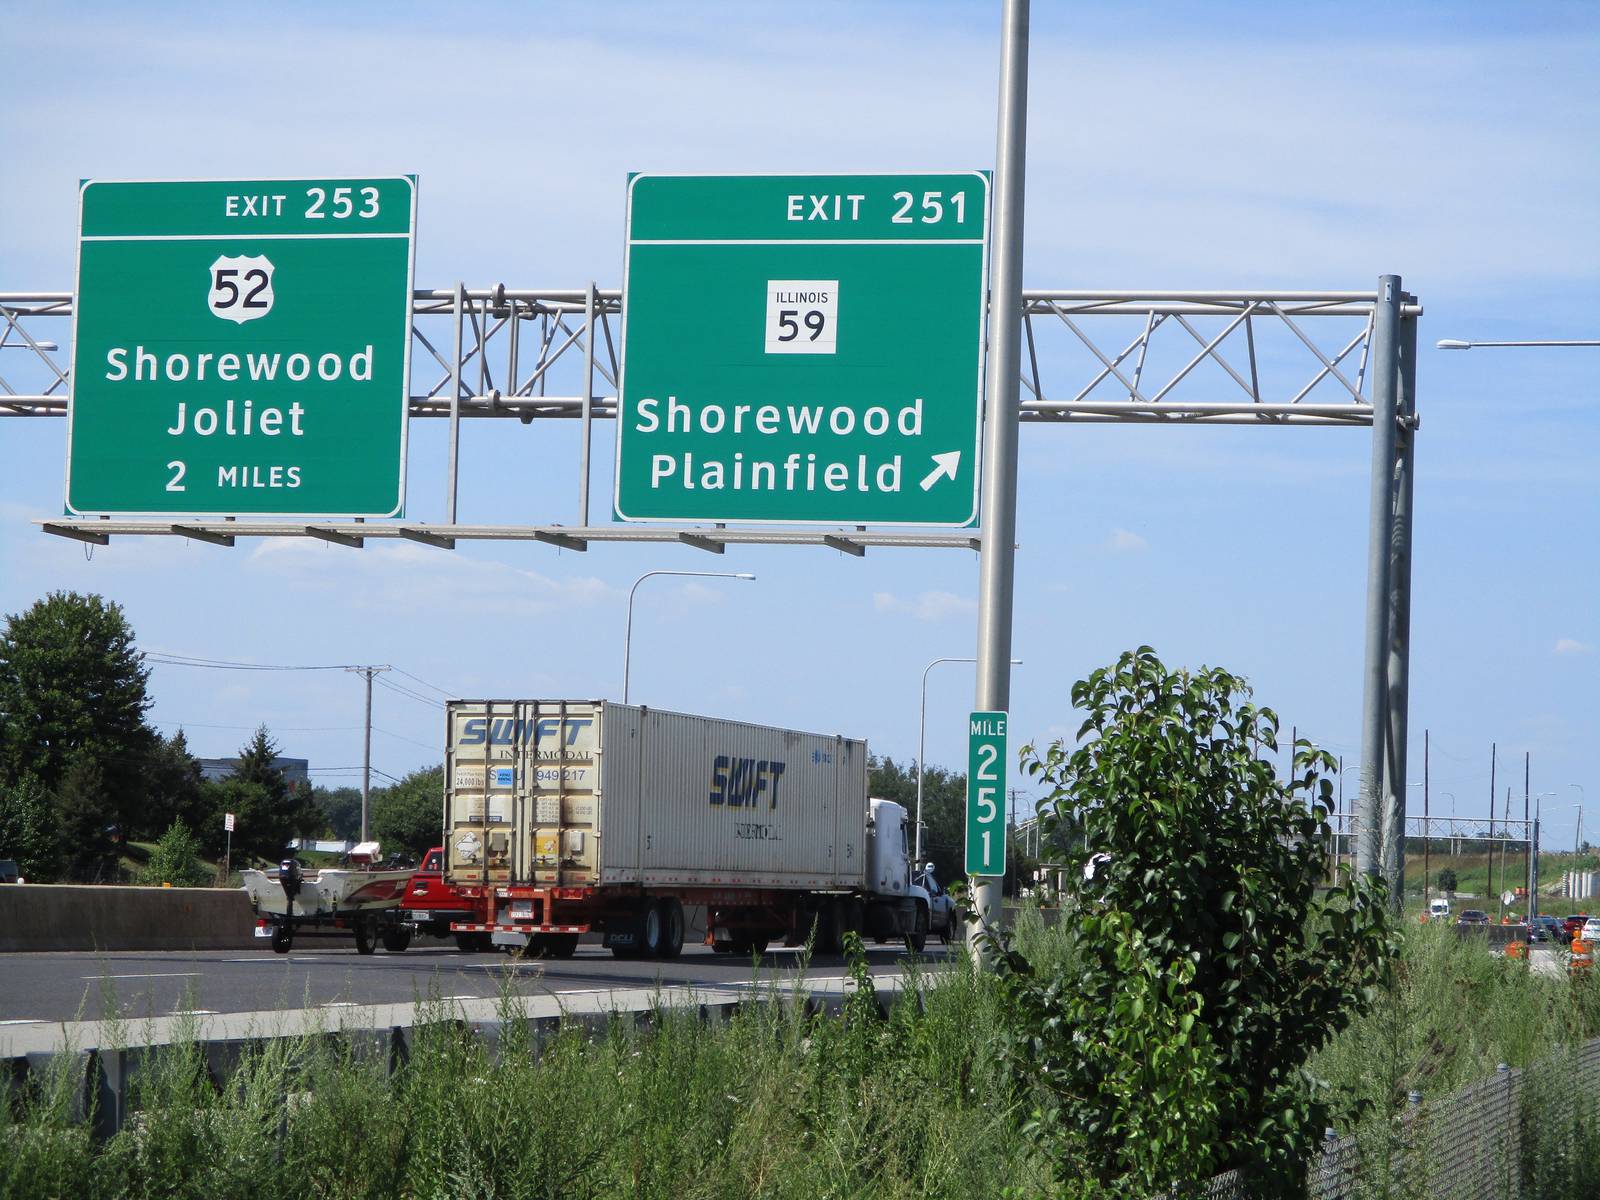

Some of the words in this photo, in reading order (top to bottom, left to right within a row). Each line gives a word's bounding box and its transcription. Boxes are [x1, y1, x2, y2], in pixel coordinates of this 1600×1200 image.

[225, 195, 287, 217] EXIT
[304, 187, 380, 219] 253
[787, 194, 865, 221] EXIT
[891, 191, 965, 224] 251
[213, 269, 269, 309] 52
[776, 292, 828, 304] ILLINOIS
[777, 310, 825, 342] 59
[105, 345, 373, 382] Shorewood
[167, 399, 305, 436] Joliet
[635, 396, 923, 436] Shorewood
[165, 460, 187, 492] 2
[217, 465, 301, 488] MILES
[651, 453, 901, 492] Plainfield
[459, 719, 593, 745] SWIFT
[970, 720, 1006, 736] MILE
[500, 750, 593, 760] INTERMODAL
[709, 755, 786, 811] SWIFT
